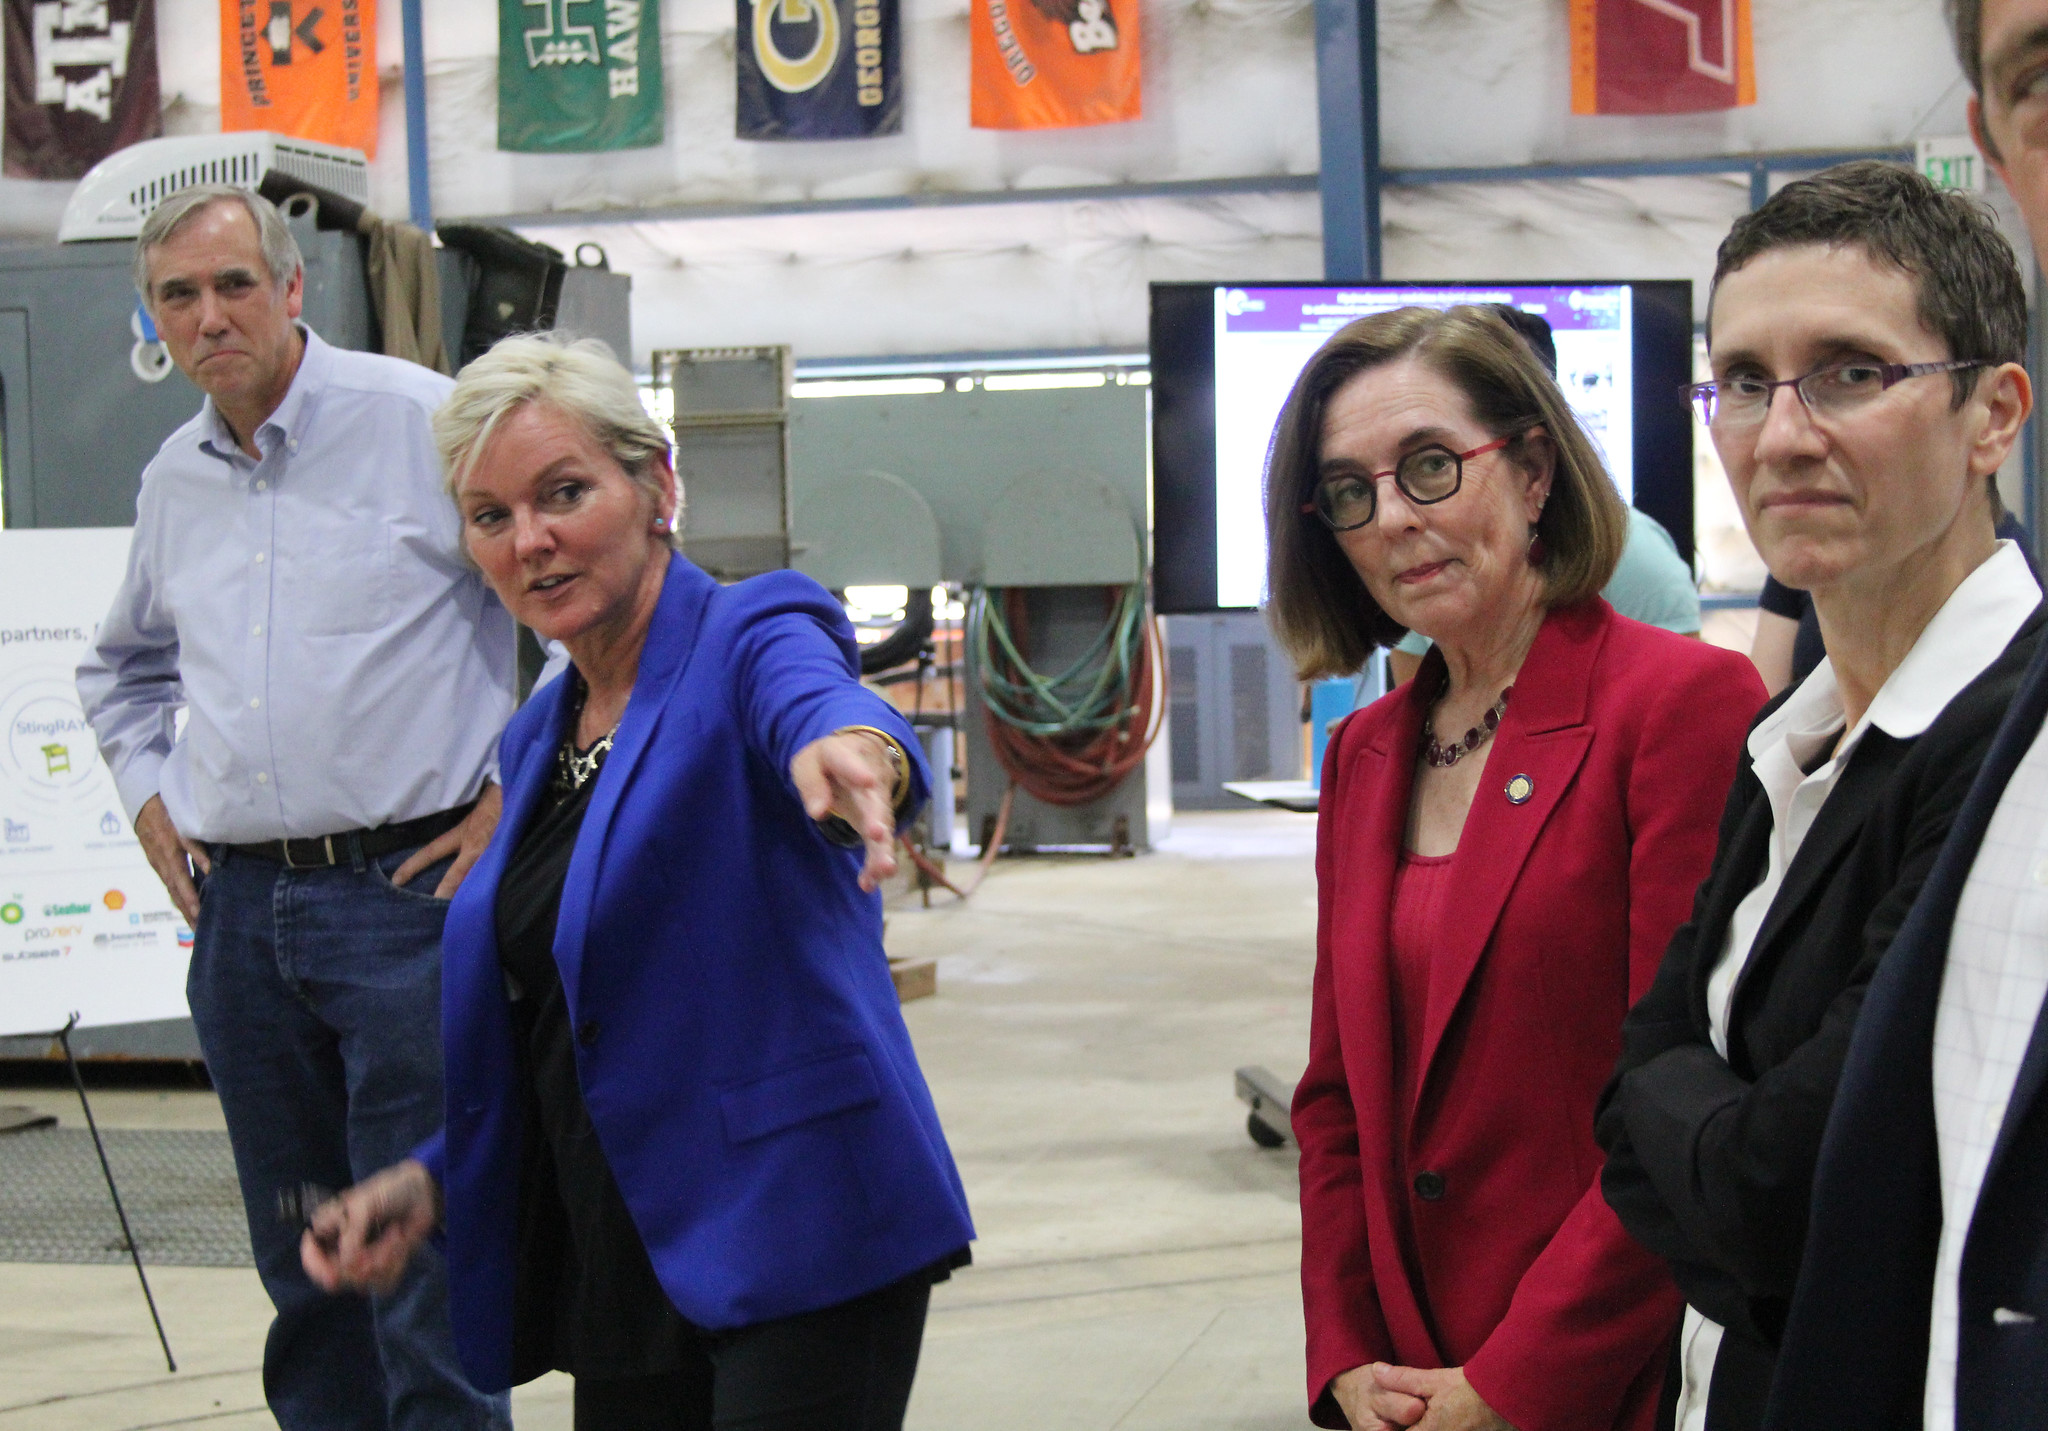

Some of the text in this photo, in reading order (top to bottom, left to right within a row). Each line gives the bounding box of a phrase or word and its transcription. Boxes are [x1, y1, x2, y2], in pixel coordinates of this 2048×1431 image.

[1925, 155, 1975, 190] EXIT
[1, 625, 88, 646] partners,
[16, 719, 86, 737] StingRAY
